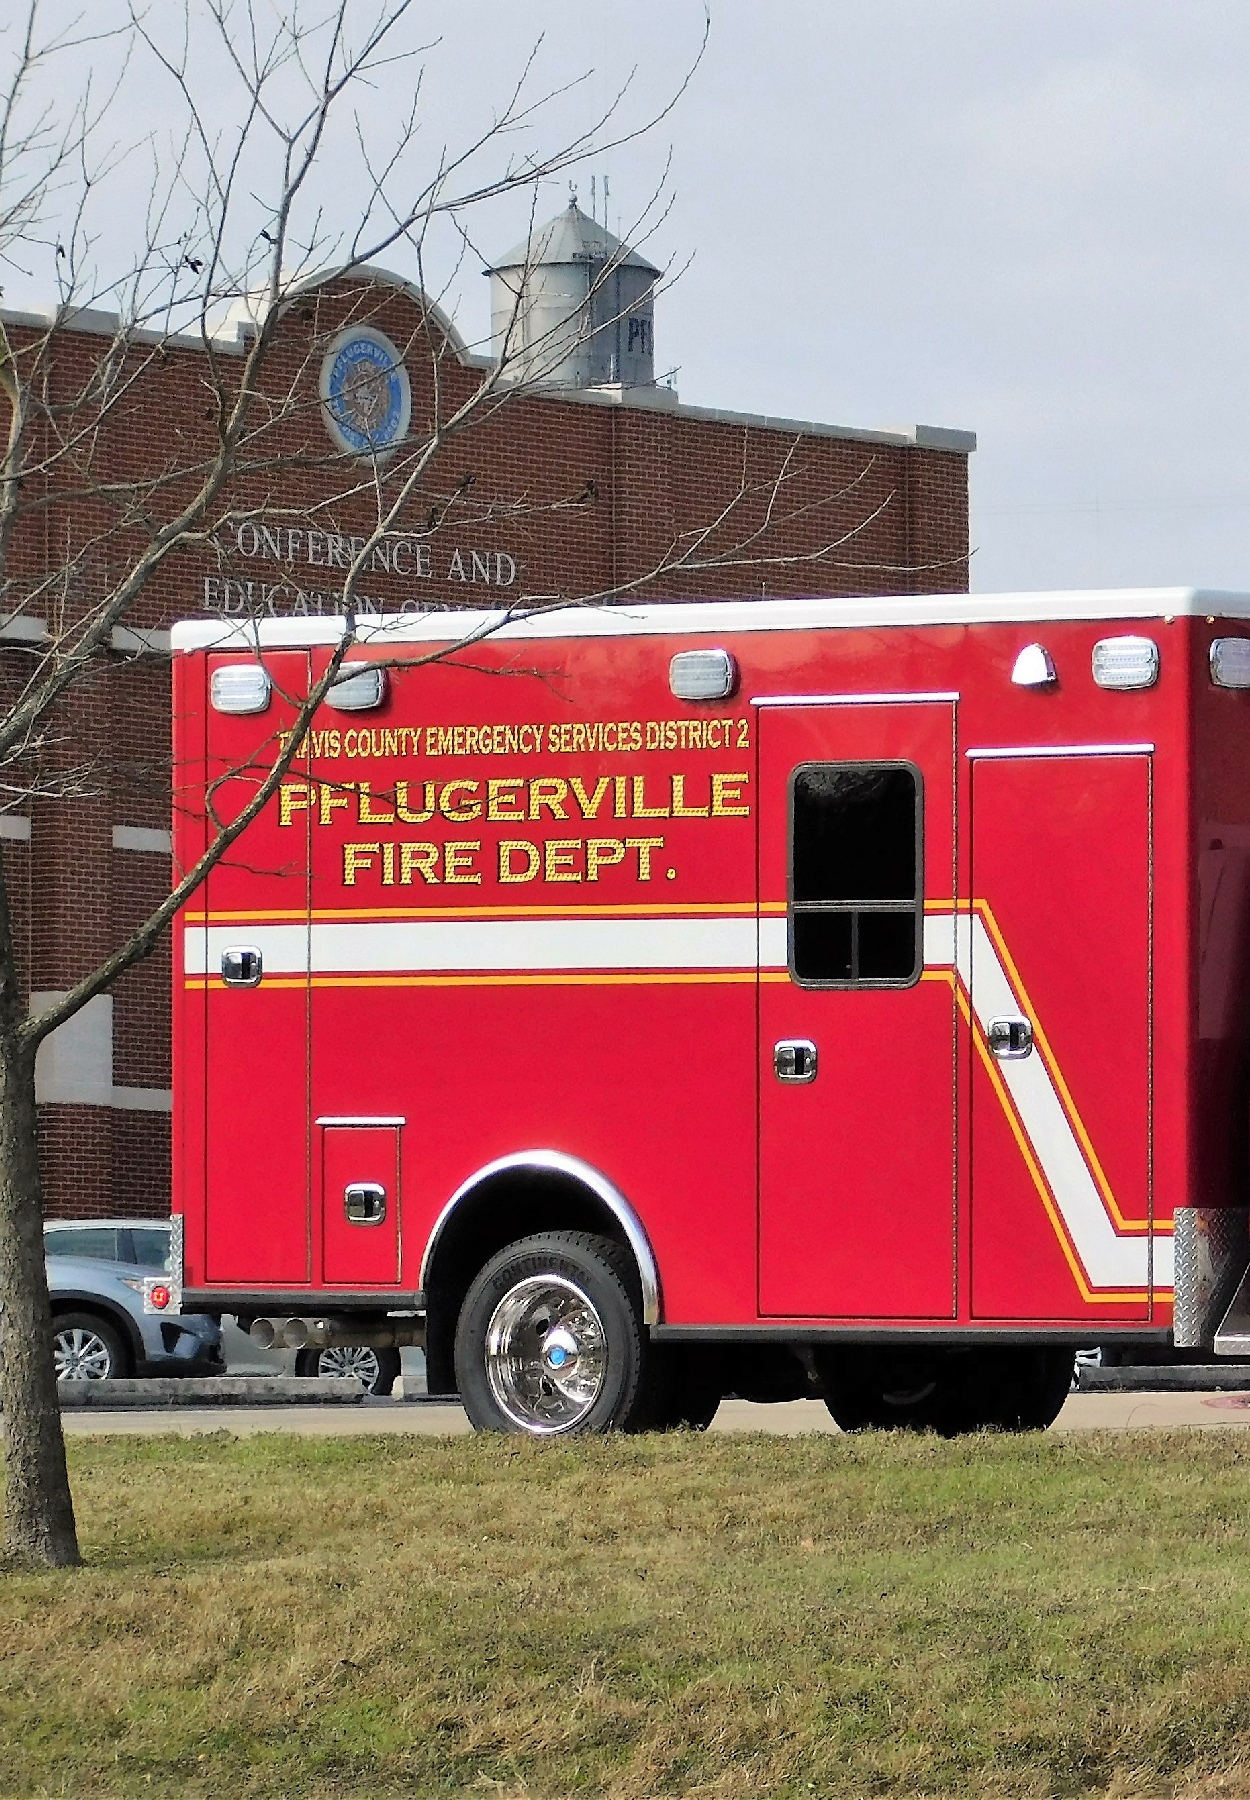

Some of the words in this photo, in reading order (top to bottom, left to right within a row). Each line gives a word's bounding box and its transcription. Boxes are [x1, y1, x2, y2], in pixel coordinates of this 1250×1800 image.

[226, 520, 433, 578] ONFERENCE
[448, 548, 516, 586] AND
[278, 728, 341, 759] TAVIS
[344, 727, 422, 758] COUNTY
[425, 724, 545, 756] EMERGENCY
[547, 721, 642, 752] SERVICES
[645, 719, 734, 750] DISTRICT
[737, 718, 750, 748] 2
[278, 772, 750, 826] PFLUGERVILLE
[343, 841, 482, 885] FIRE
[498, 836, 677, 884] DEPT.
